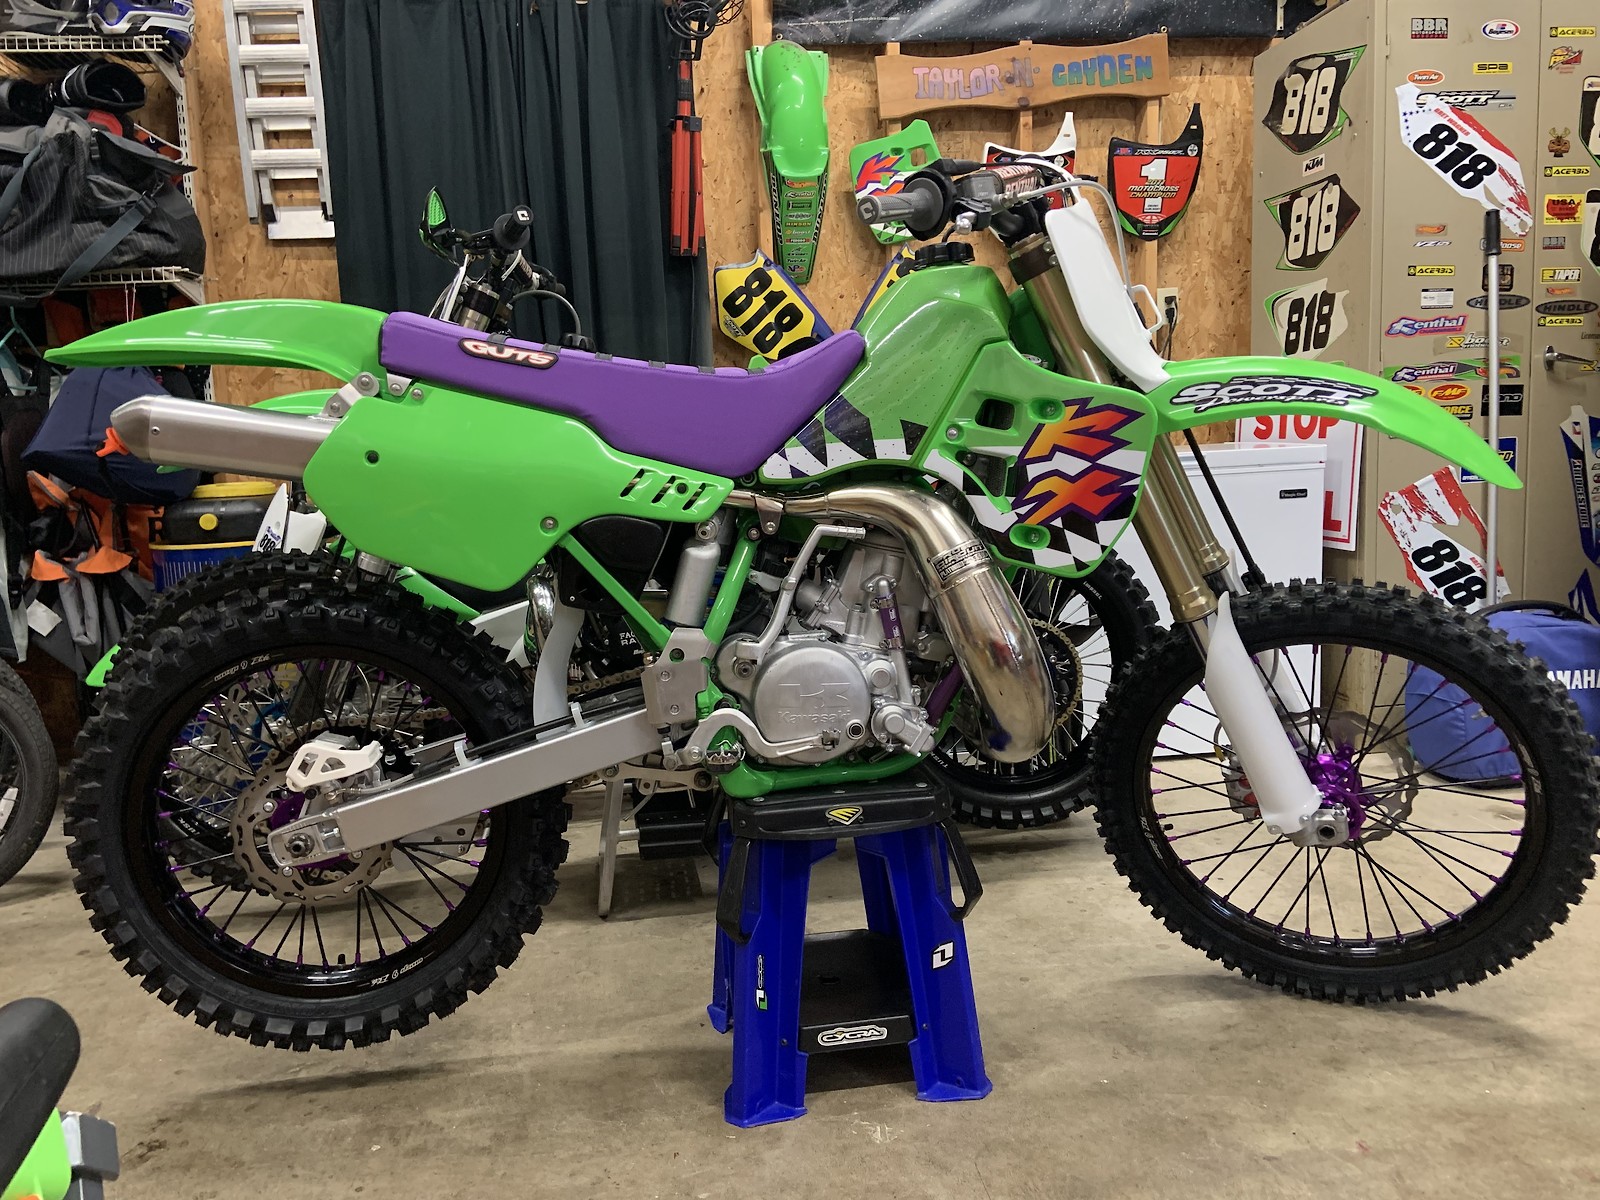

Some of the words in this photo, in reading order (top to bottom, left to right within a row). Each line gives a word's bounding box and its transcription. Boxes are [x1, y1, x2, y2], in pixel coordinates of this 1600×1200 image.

[1412, 19, 1447, 31] BBR
[912, 63, 1004, 100] TAYLOR
[1281, 66, 1337, 135] 818
[1304, 156, 1324, 172] KTM
[1412, 123, 1498, 190] 818
[1129, 191, 1177, 199] CHAMPION
[1552, 198, 1576, 206] USA
[1287, 184, 1341, 261] 818
[1554, 269, 1581, 281] TAPER
[722, 266, 804, 355] 818
[1543, 303, 1592, 313] HINDLE
[1284, 289, 1336, 356] 818
[1387, 315, 1466, 336] Renthal
[462, 340, 555, 366] GUTS
[1392, 365, 1456, 382] Renthal
[1171, 383, 1364, 404] SCOTT
[1431, 387, 1468, 398] FMF
[1253, 414, 1340, 440] STOP
[1570, 458, 1590, 529] BRIDGESTONE
[1411, 539, 1487, 607] 818
[822, 1028, 881, 1042] CYCRA
